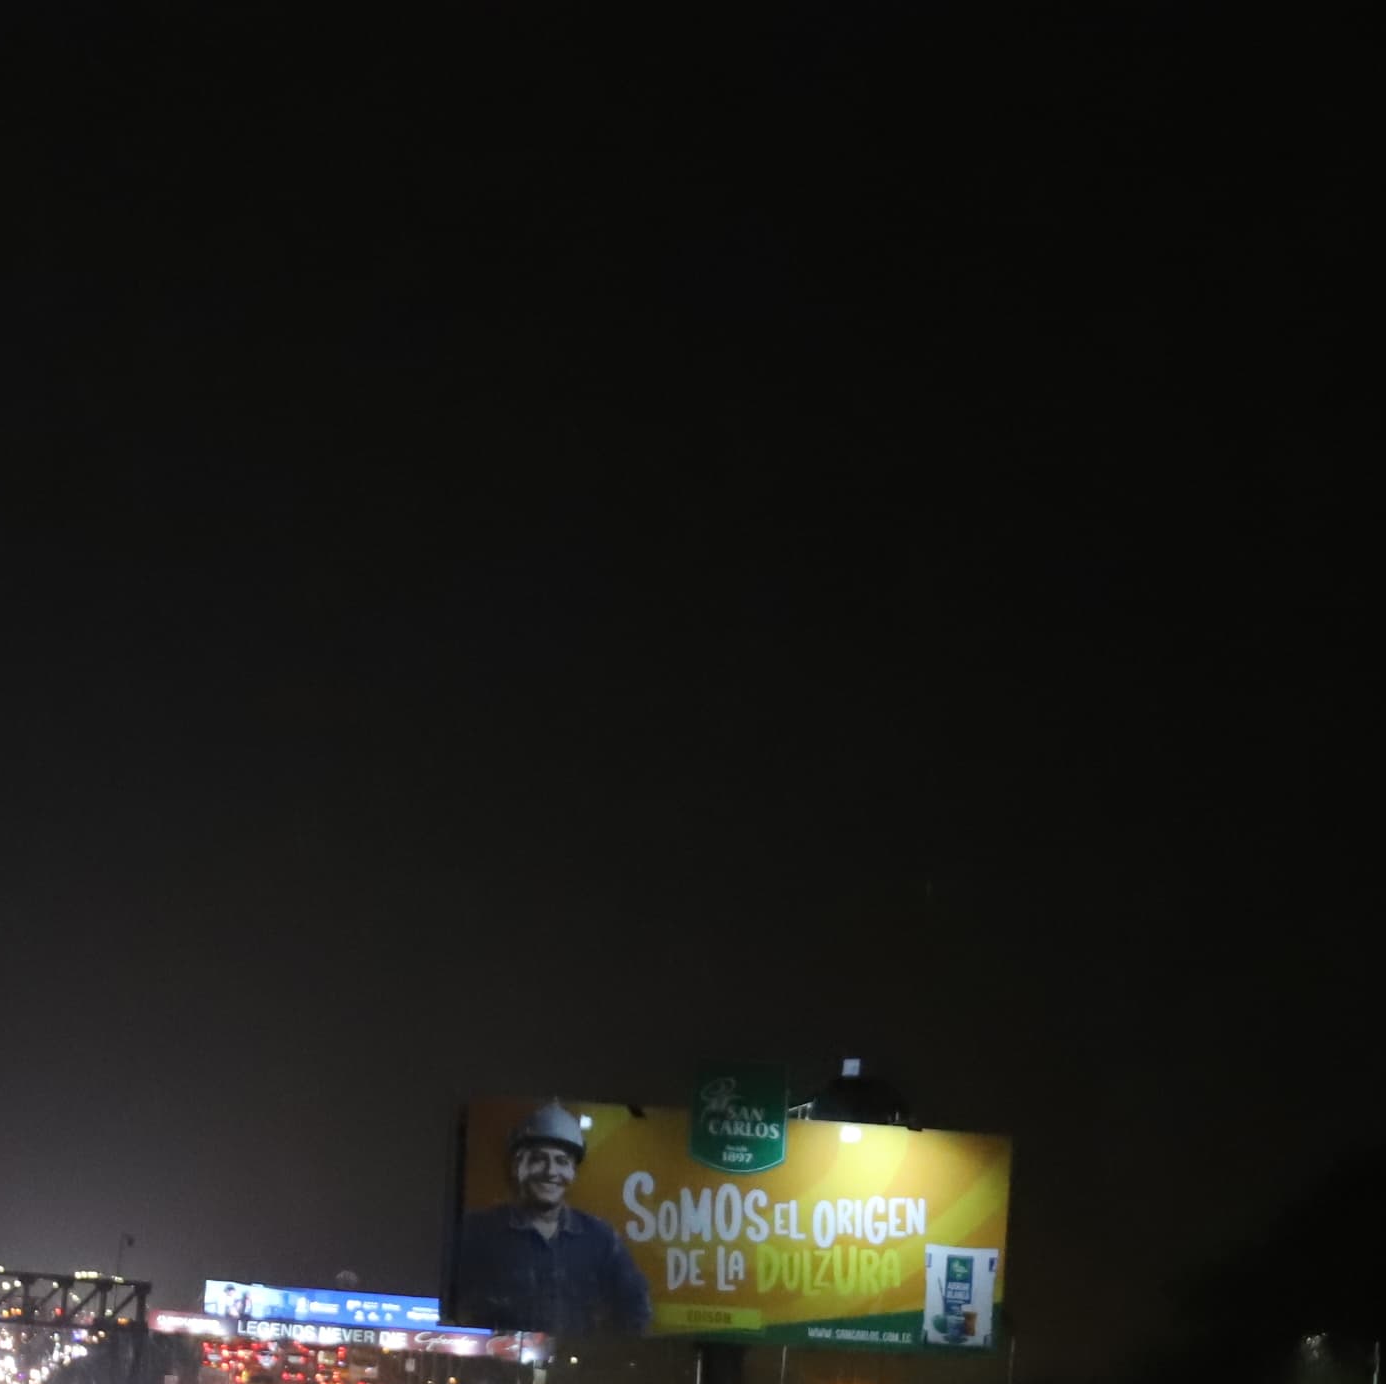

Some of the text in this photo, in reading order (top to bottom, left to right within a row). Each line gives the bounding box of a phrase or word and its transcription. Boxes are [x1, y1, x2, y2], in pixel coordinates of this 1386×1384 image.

[728, 1106, 764, 1122] SAN
[708, 1120, 780, 1139] CARLOS
[722, 1151, 754, 1164] 1897
[622, 1170, 926, 1249] SOMOS EL ORIGEN
[666, 1245, 902, 1297] DE LA DULZURA
[237, 1320, 317, 1342] LEGENDS
[318, 1325, 374, 1344] NEVER
[378, 1331, 408, 1348] DIE
